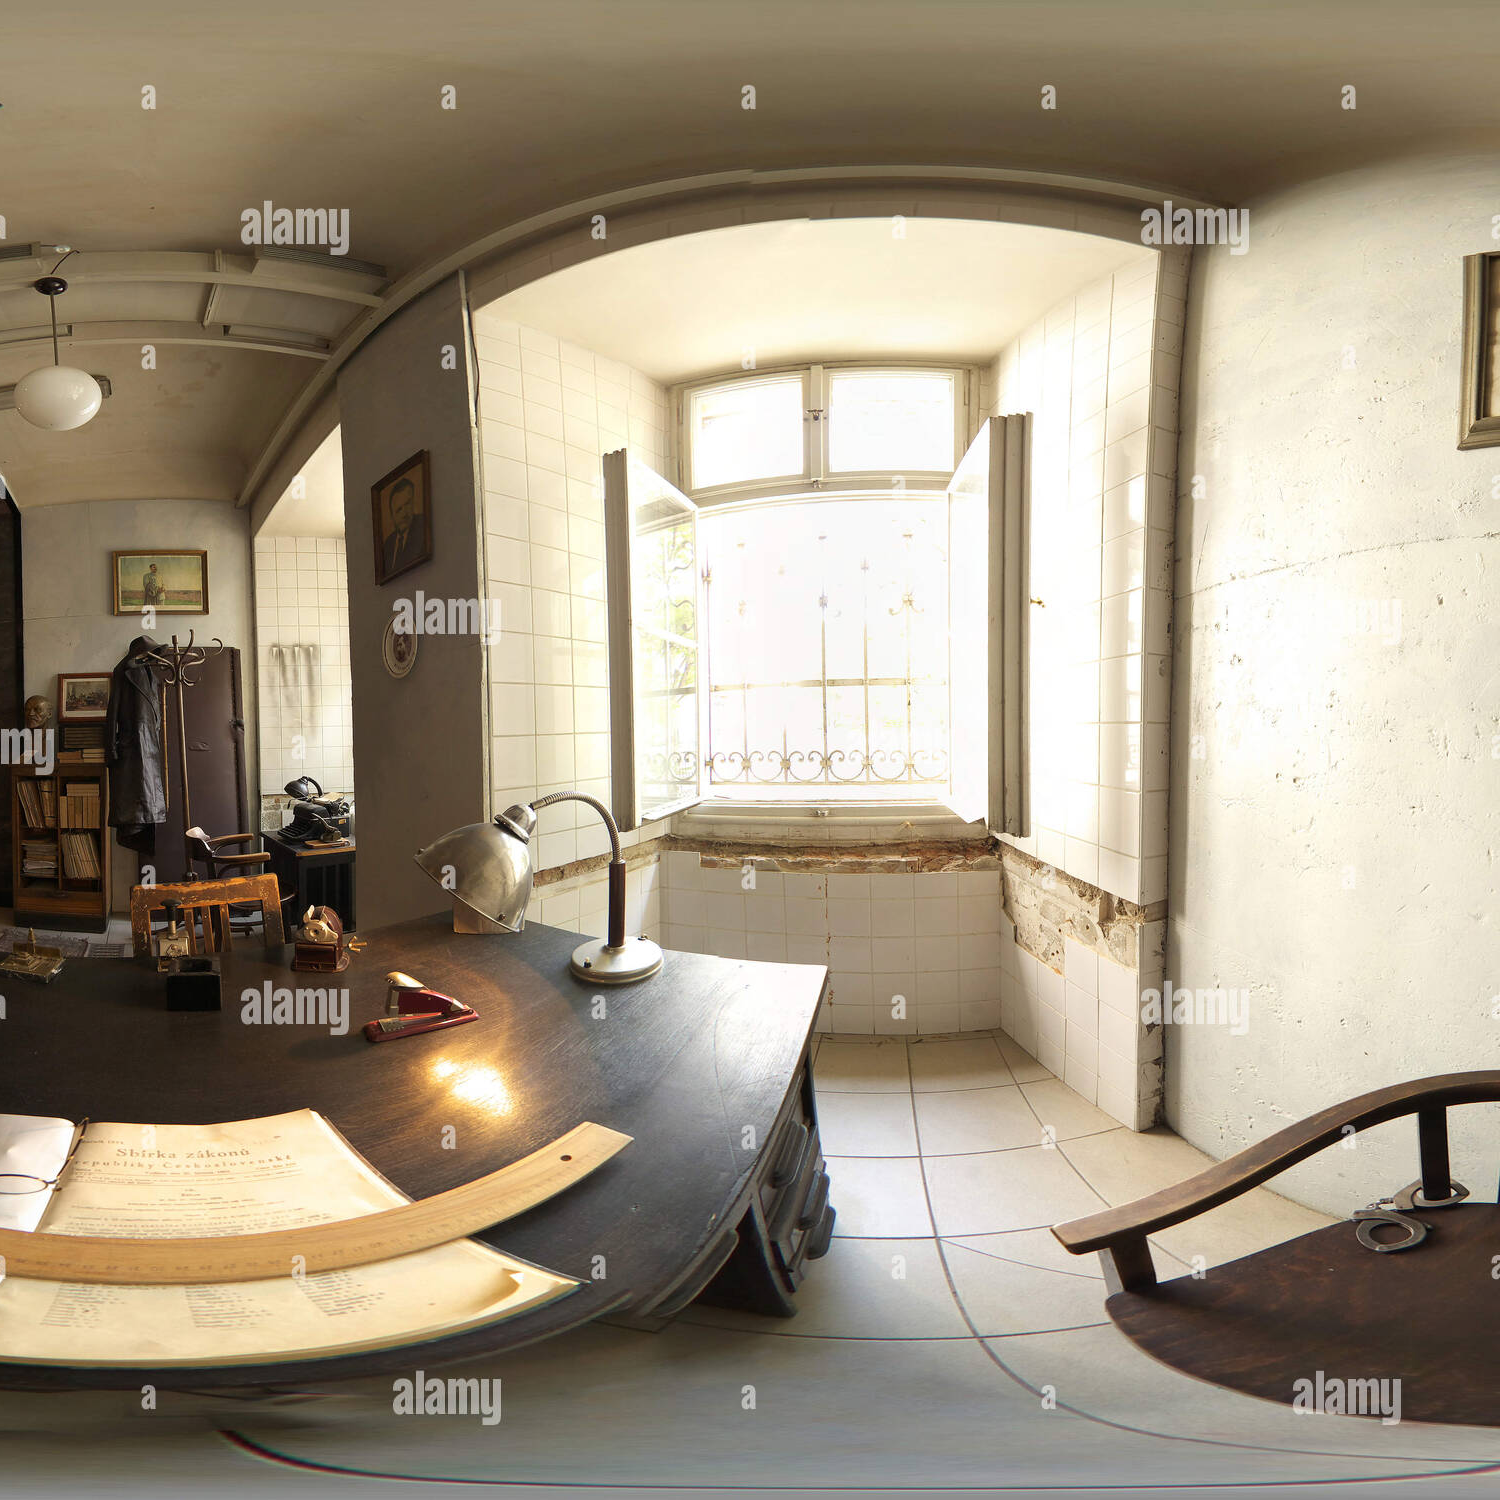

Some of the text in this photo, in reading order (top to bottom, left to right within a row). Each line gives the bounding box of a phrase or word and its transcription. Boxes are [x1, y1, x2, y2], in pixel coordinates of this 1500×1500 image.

[116, 1147, 251, 1159] Sbírka zákonů
[75, 1160, 155, 1169] republiky
